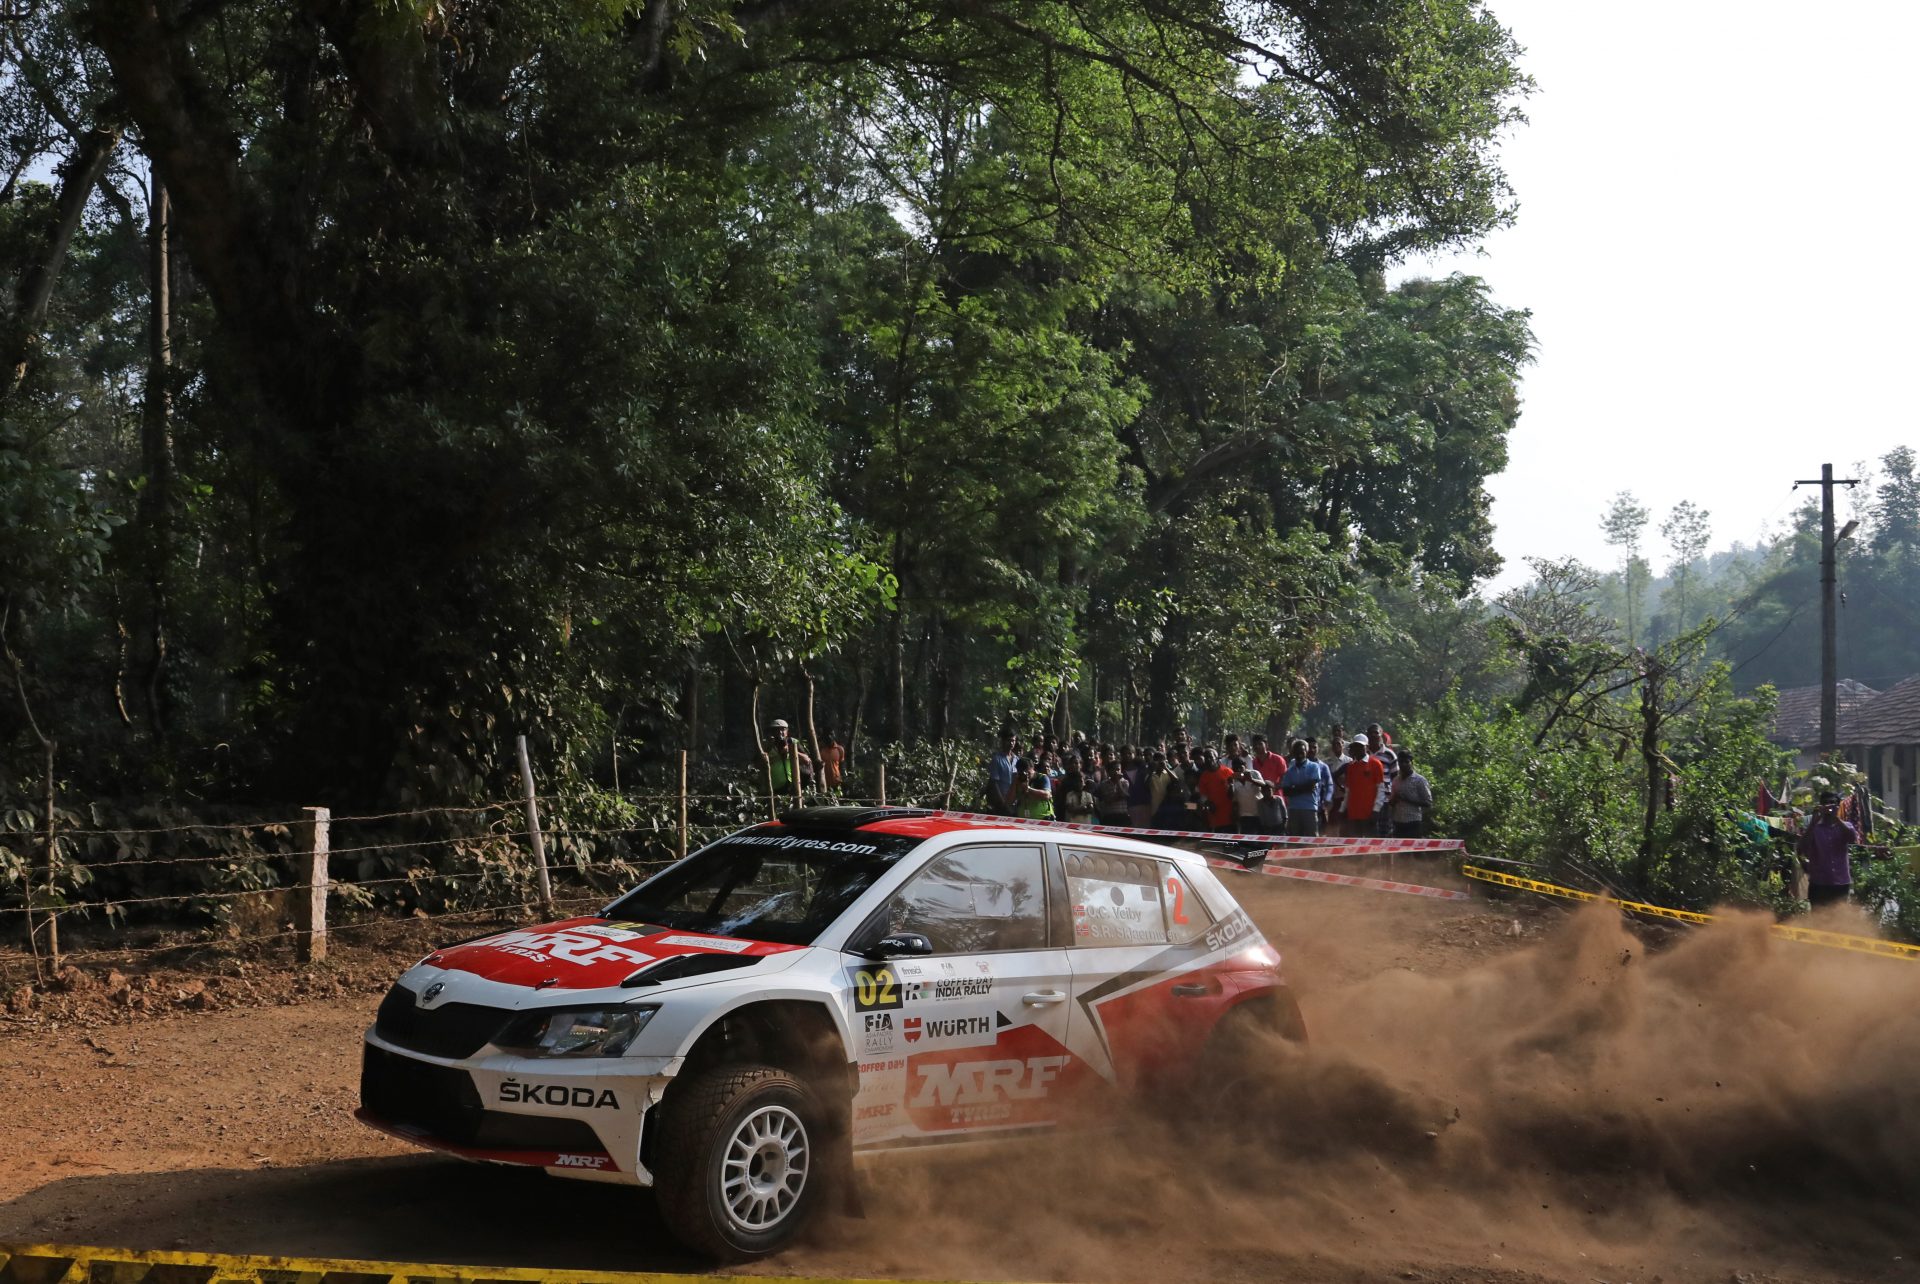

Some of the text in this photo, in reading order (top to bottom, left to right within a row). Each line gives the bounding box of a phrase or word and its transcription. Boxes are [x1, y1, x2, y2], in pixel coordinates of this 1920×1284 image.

[722, 835, 877, 855] www.mrftyres.com
[1167, 878, 1189, 925] 2
[463, 932, 656, 967] MRF
[1206, 914, 1255, 952] ŠKODA
[855, 969, 897, 1006] 02
[935, 984, 993, 998] INDIA RALLY
[499, 1077, 621, 1110] ŠKODA
[908, 1055, 1072, 1108] MRF
[554, 1153, 609, 1168] MRF
